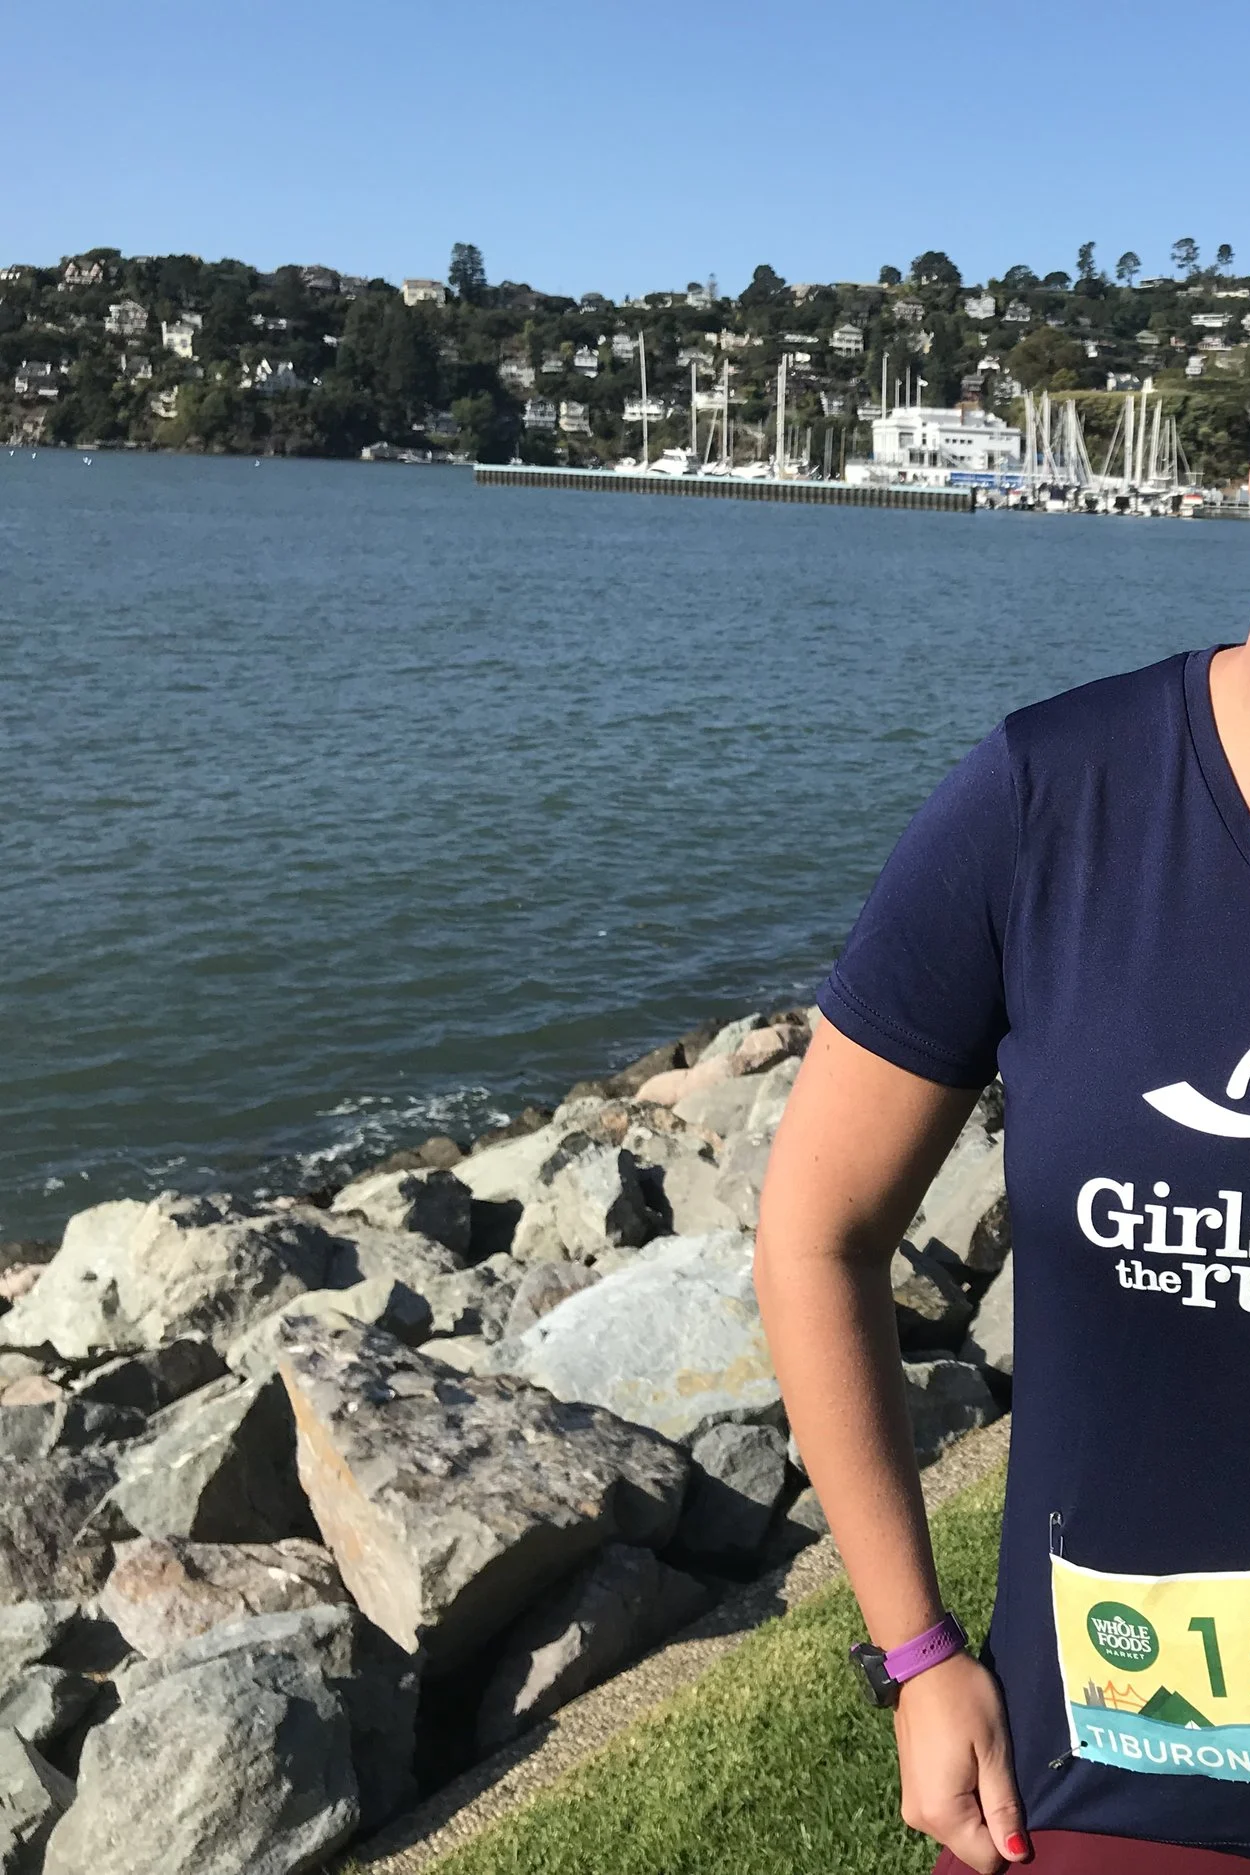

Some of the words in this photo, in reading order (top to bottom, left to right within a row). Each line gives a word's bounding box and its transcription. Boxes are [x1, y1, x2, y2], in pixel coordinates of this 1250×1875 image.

[1115, 1260, 1181, 1293] the
[1091, 1616, 1150, 1640] WHOLE
[1097, 1632, 1152, 1653] FOODS
[1105, 1648, 1145, 1660] MARKET
